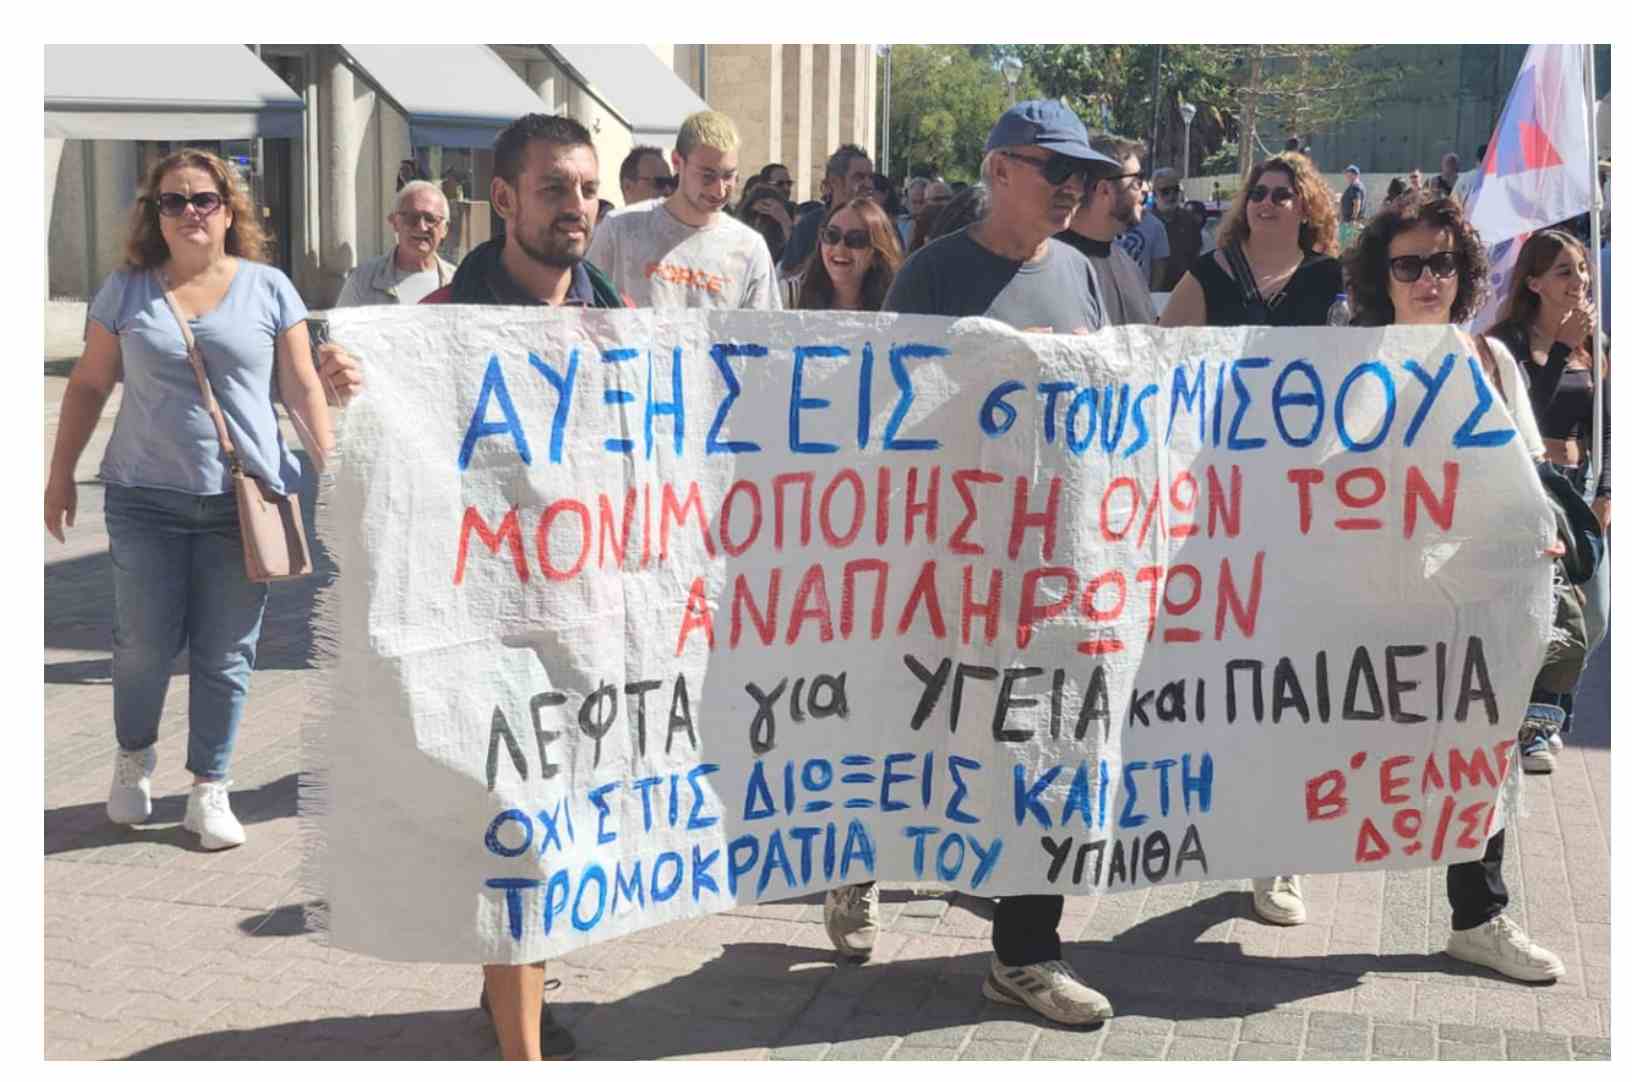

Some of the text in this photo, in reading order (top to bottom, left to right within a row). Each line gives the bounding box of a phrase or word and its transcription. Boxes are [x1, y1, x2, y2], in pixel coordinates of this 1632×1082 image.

[458, 342, 951, 470] ΑΥΞΗΣΕΙΣ
[1165, 352, 1518, 453] ΜΙΣΘΟΥΣ
[454, 461, 1460, 587] ΜΟΝΙΜΟΠΟΙΗΣΗ ΟΛΩΝ ΤΩΝ
[676, 551, 1265, 658] ΑΝΑΠΛΗΡΩΤΩΝ
[486, 635, 1499, 791] ΛΕΦΤΑ για ΥΓΕΙΑ και ΠΑΙΔΕΙΑ
[484, 750, 1214, 858] ΟΧΙ ΣΤΙΣ ΔΙΩΞΕΙΣ ΚΑΙ ΣΤΗ
[485, 818, 1209, 943] ΤΡΟΜΟΚΡΑΤΙΑ ΤΟΥ ΥΠΑΙΘΑ
